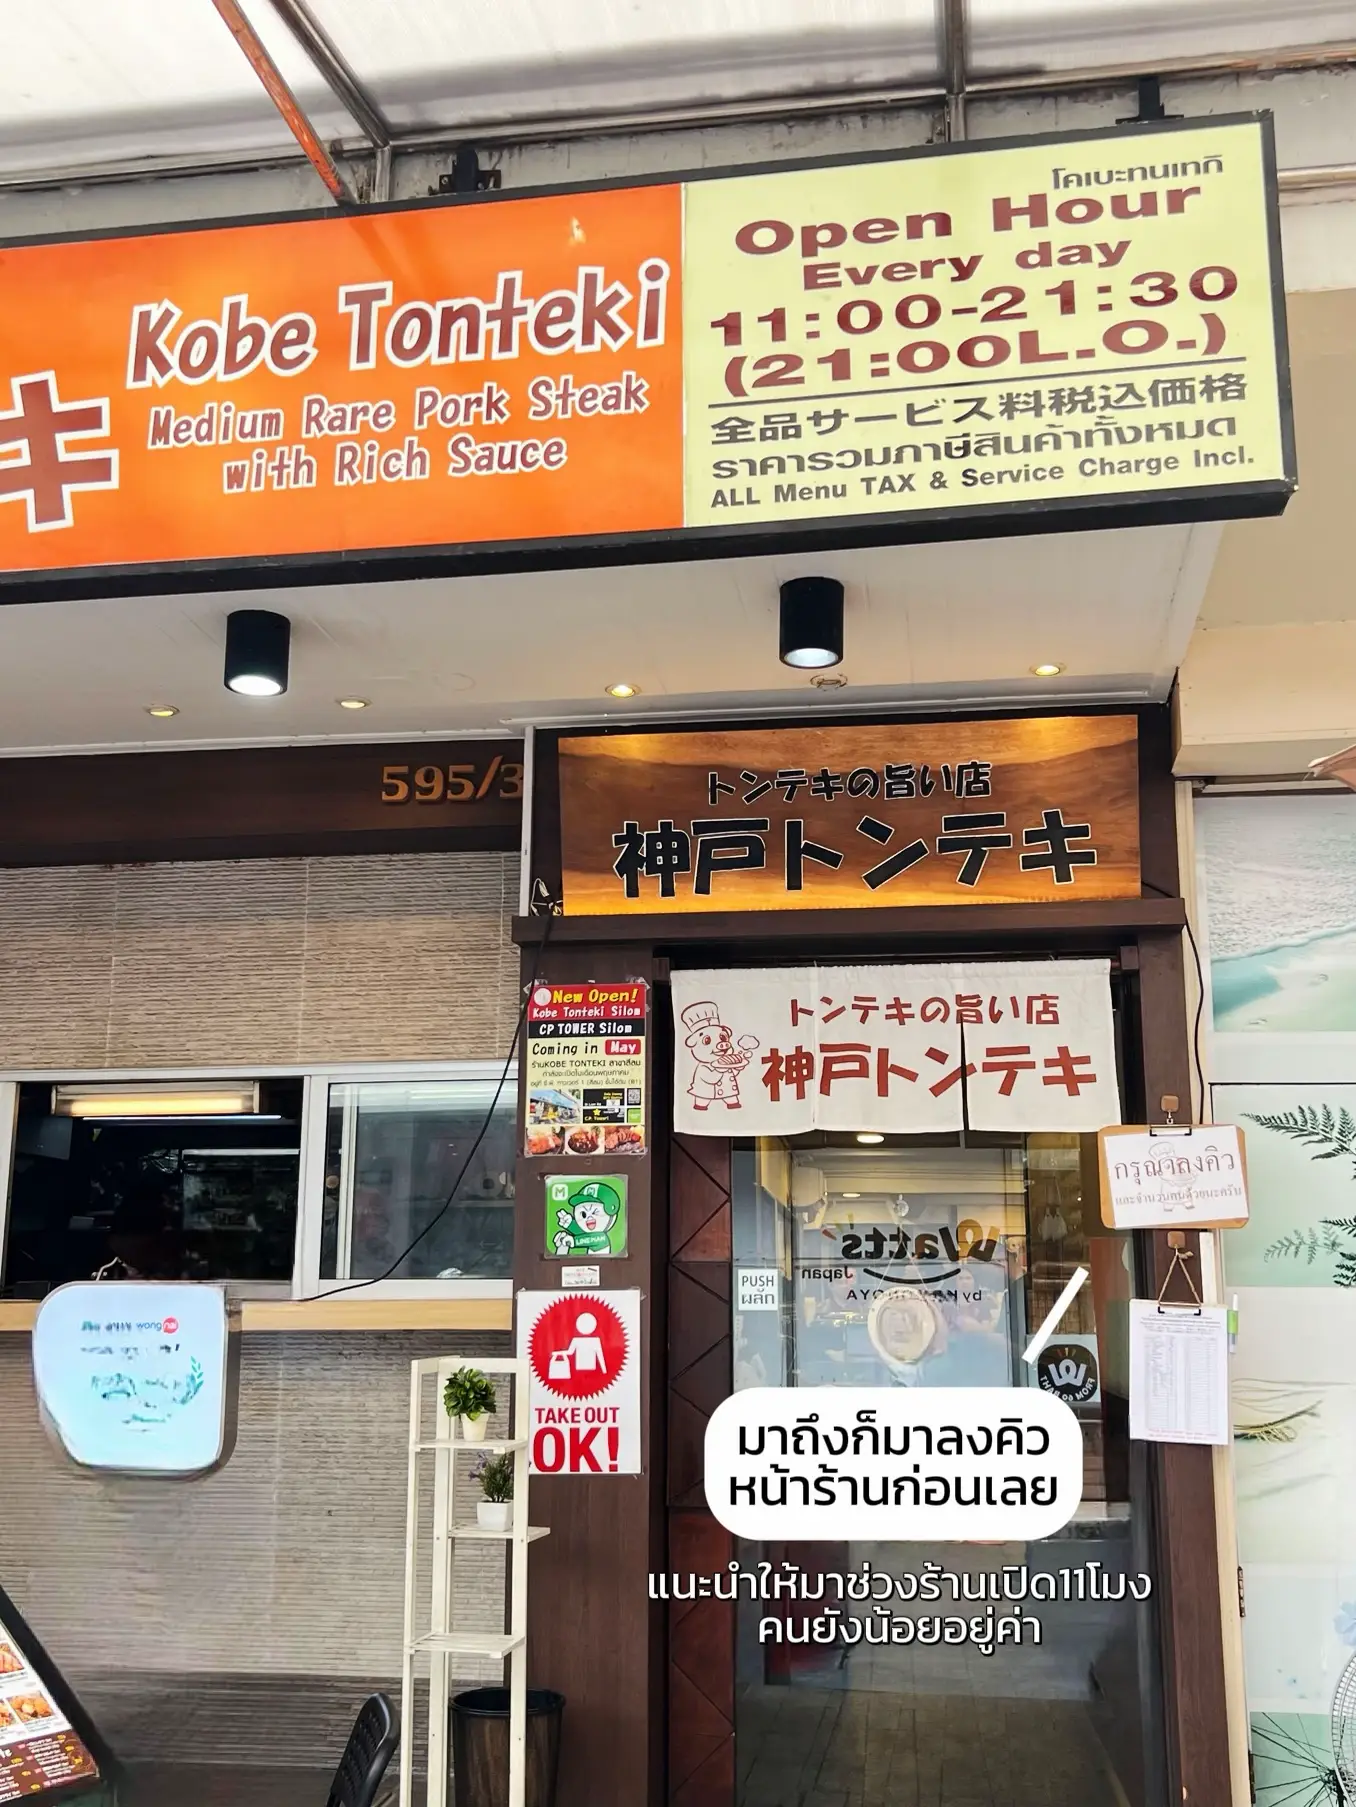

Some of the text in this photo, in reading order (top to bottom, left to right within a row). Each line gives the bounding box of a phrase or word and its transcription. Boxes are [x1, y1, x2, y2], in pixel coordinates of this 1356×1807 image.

[735, 186, 1201, 257] Open Hour
[803, 240, 1131, 291] Every day
[126, 258, 669, 389] Kobe Tonteki
[710, 266, 1238, 347] 11:00-21:30
[723, 312, 1226, 397] (21:00L.O.)
[148, 371, 650, 449] Medium Rare Pork Steak
[711, 373, 1247, 445] 全品サービス料税込価格
[0, 370, 119, 532] キ
[223, 435, 567, 494] with Rich Sauce
[712, 416, 1236, 479] ราคารวมภาษีสินค้าทั้งหมด
[711, 446, 1254, 508] ALL Menu TAX & Service Charge Incl.
[708, 760, 993, 805] トンテキの旨い店
[612, 808, 1097, 899] 神戸トンテキ
[532, 1005, 641, 1018] Kobe Tonteki Silom
[553, 988, 639, 1004] New Open!
[790, 993, 1060, 1027] トンテキの旨い店
[532, 1041, 637, 1056] Coming in May
[539, 1022, 632, 1035] CP TOWER Silom
[569, 1060, 606, 1068] TONTEKI
[761, 1043, 1097, 1102] 神戸トンテキ
[1114, 1145, 1235, 1185] กรุณาลงคิว
[741, 1288, 775, 1305] ผลัก
[742, 1275, 774, 1287] PUSH
[535, 1407, 620, 1424] TAKE OUT
[532, 1427, 619, 1472] OK!
